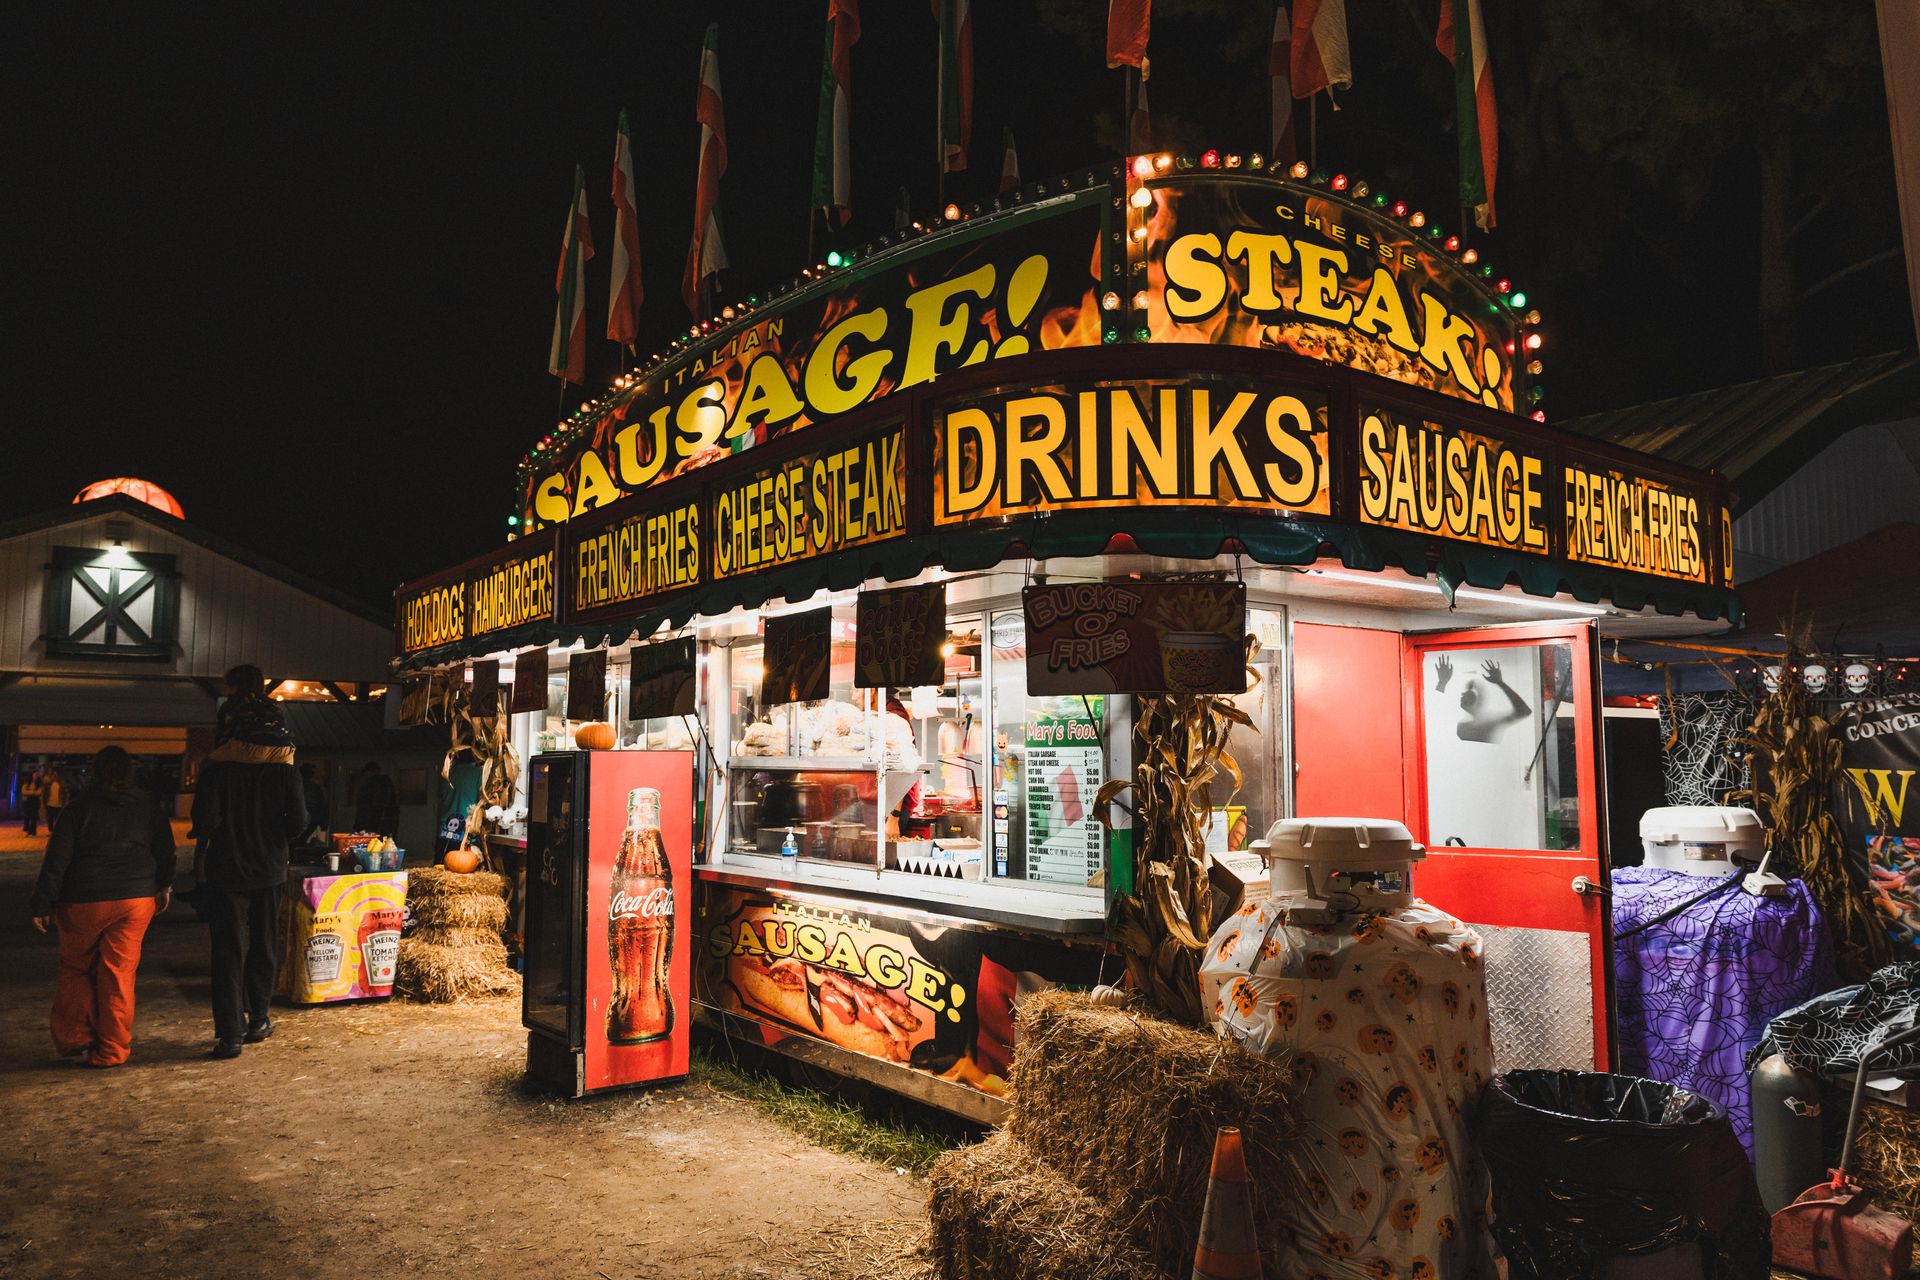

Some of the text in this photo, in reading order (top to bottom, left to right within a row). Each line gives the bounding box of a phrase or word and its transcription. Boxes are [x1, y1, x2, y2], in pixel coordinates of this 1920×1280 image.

[1275, 204, 1417, 270] CHEESE
[1164, 231, 1502, 409] STEAK!
[663, 317, 784, 395] ITALIAN
[535, 254, 1049, 531] SAUSAGE!
[946, 388, 1316, 514] DRINKS
[717, 431, 904, 573] CHEESE STEAK
[1361, 415, 1544, 547] SAUSAGE
[1565, 467, 1701, 577] FRENCH FRIES
[577, 503, 700, 604] FRENCH FRIES
[406, 581, 465, 647] HOT DOGS
[474, 549, 553, 636] HAMBURGERS
[860, 592, 920, 634] CORN
[1026, 584, 1142, 629] BUCKET
[860, 629, 914, 667] DOGS
[1049, 629, 1131, 669] FRIES
[1026, 719, 1100, 746] Mary's Food
[1046, 759, 1060, 767] CHEESE
[309, 915, 342, 925] Mary's
[609, 887, 675, 921] Coca-Cola
[772, 902, 872, 933] ITALIAN
[309, 954, 339, 963] MUSTARD
[312, 936, 336, 946] HEINZ
[312, 948, 336, 956] YELLOW
[374, 936, 398, 945] HEINZ
[710, 919, 967, 1024] SAUSAGE!
